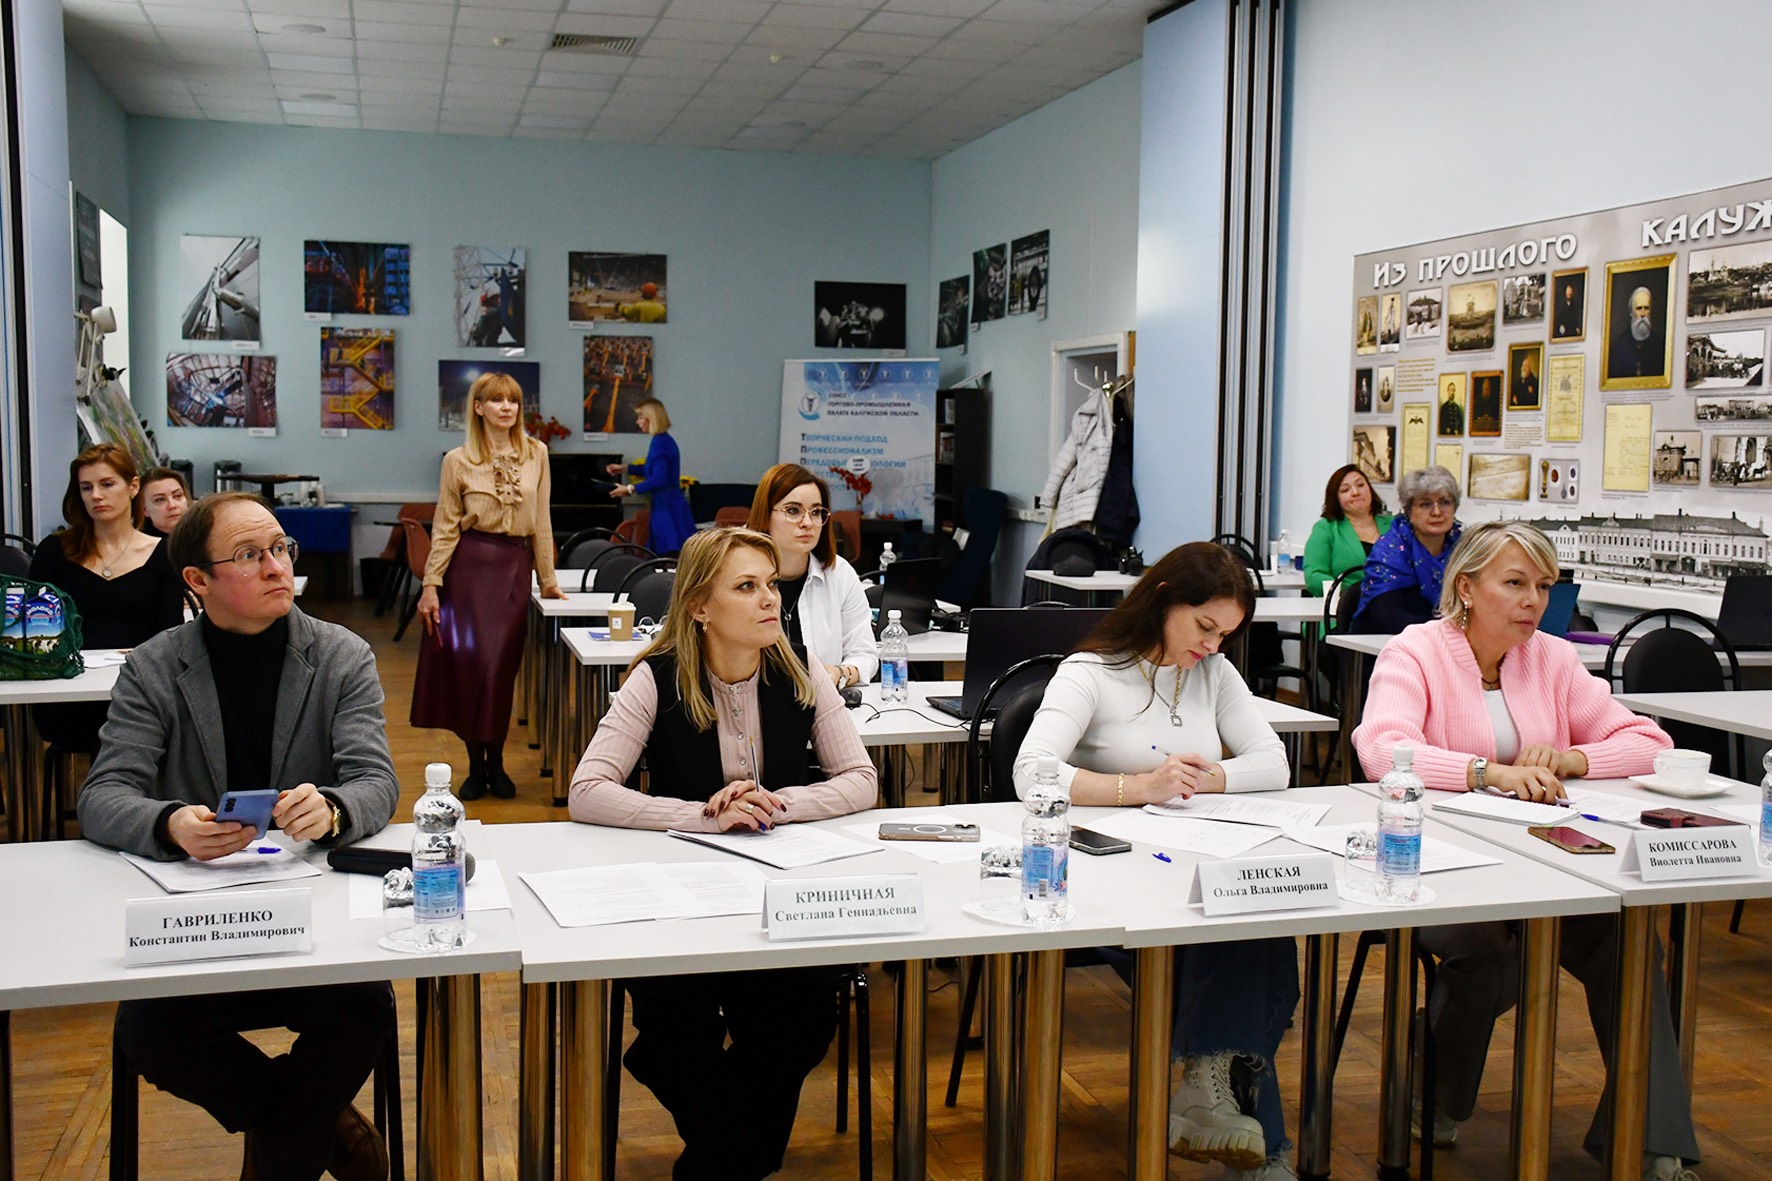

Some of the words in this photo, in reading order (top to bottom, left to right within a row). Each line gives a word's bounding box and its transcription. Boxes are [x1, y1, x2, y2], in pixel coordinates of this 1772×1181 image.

[1373, 259, 1408, 289] ИЗ
[1418, 233, 1578, 282] ПРОШЛОГО
[1641, 199, 1772, 248] КАЛУЖ
[26, 606, 54, 615] МОЛОКО
[1649, 839, 1737, 853] КОМИССАРОВА
[1650, 856, 1694, 867] Виолетта
[1696, 855, 1742, 865] Ивановна
[1237, 866, 1301, 881] ЛЕНСКАЯ
[795, 887, 896, 904] КРИНИЧНАЯ
[1213, 887, 1248, 898] Ольга
[1250, 882, 1329, 895] Владимировна
[162, 909, 273, 930] ГАВРИЛЕНКО
[775, 910, 835, 922] Светлана
[838, 905, 917, 918] Геннадьевна
[129, 933, 207, 948] Константин
[211, 927, 305, 941] Владимирович
